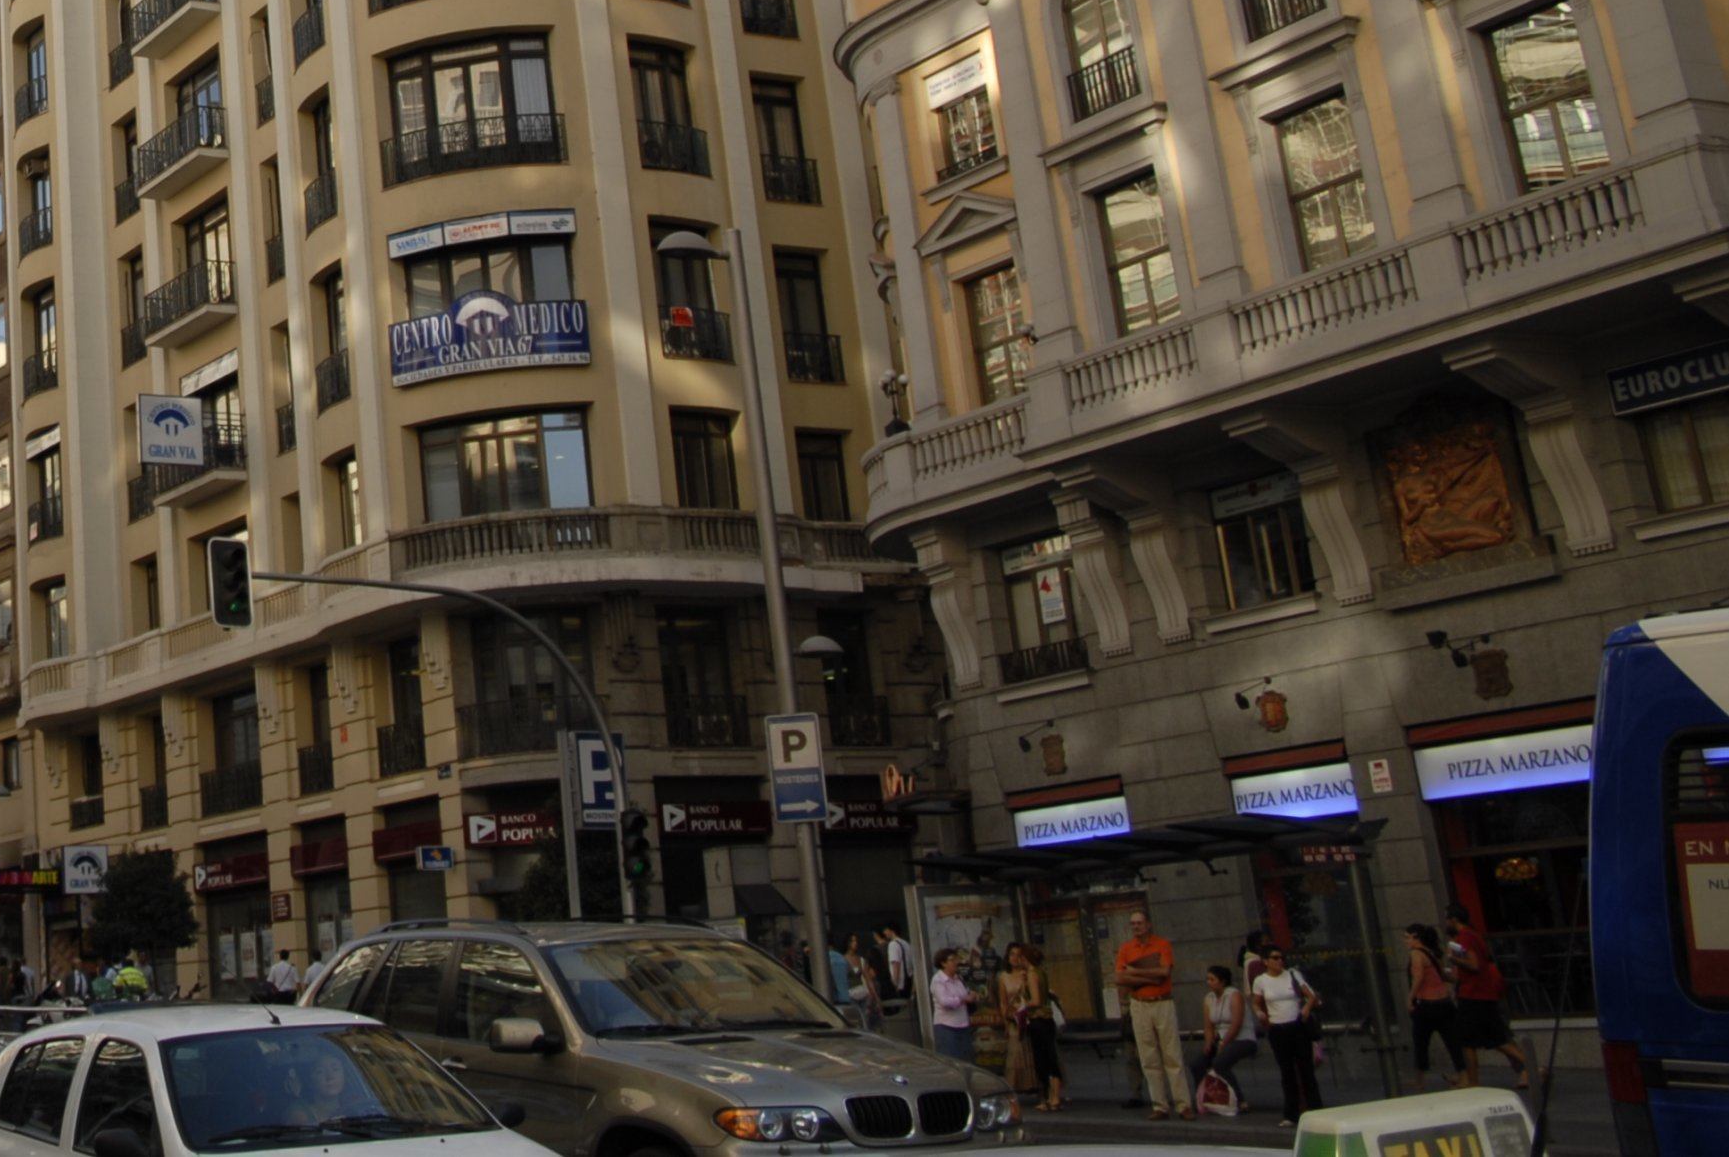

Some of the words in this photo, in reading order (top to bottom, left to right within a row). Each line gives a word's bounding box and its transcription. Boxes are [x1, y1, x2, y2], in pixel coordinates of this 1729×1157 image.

[393, 313, 452, 356] CENTRO
[513, 301, 584, 336] MEDICO
[438, 340, 482, 365] GRAN
[487, 337, 515, 358] VIA
[517, 335, 534, 355] 67
[148, 444, 176, 457] GRAN
[178, 445, 197, 459] VIA
[781, 729, 807, 763] P
[1446, 760, 1498, 781] PIZZA
[1500, 743, 1591, 773] MARZANO
[1235, 790, 1278, 811] PIZZA
[1279, 777, 1355, 805] MARZANO
[501, 813, 536, 824] BANCO
[689, 805, 720, 815] BANCO
[848, 803, 877, 812] BANCO
[691, 818, 743, 831] POPULAR
[850, 816, 899, 828] POPULAR
[1024, 821, 1059, 841] PIZZA
[1060, 812, 1125, 835] MARZANO
